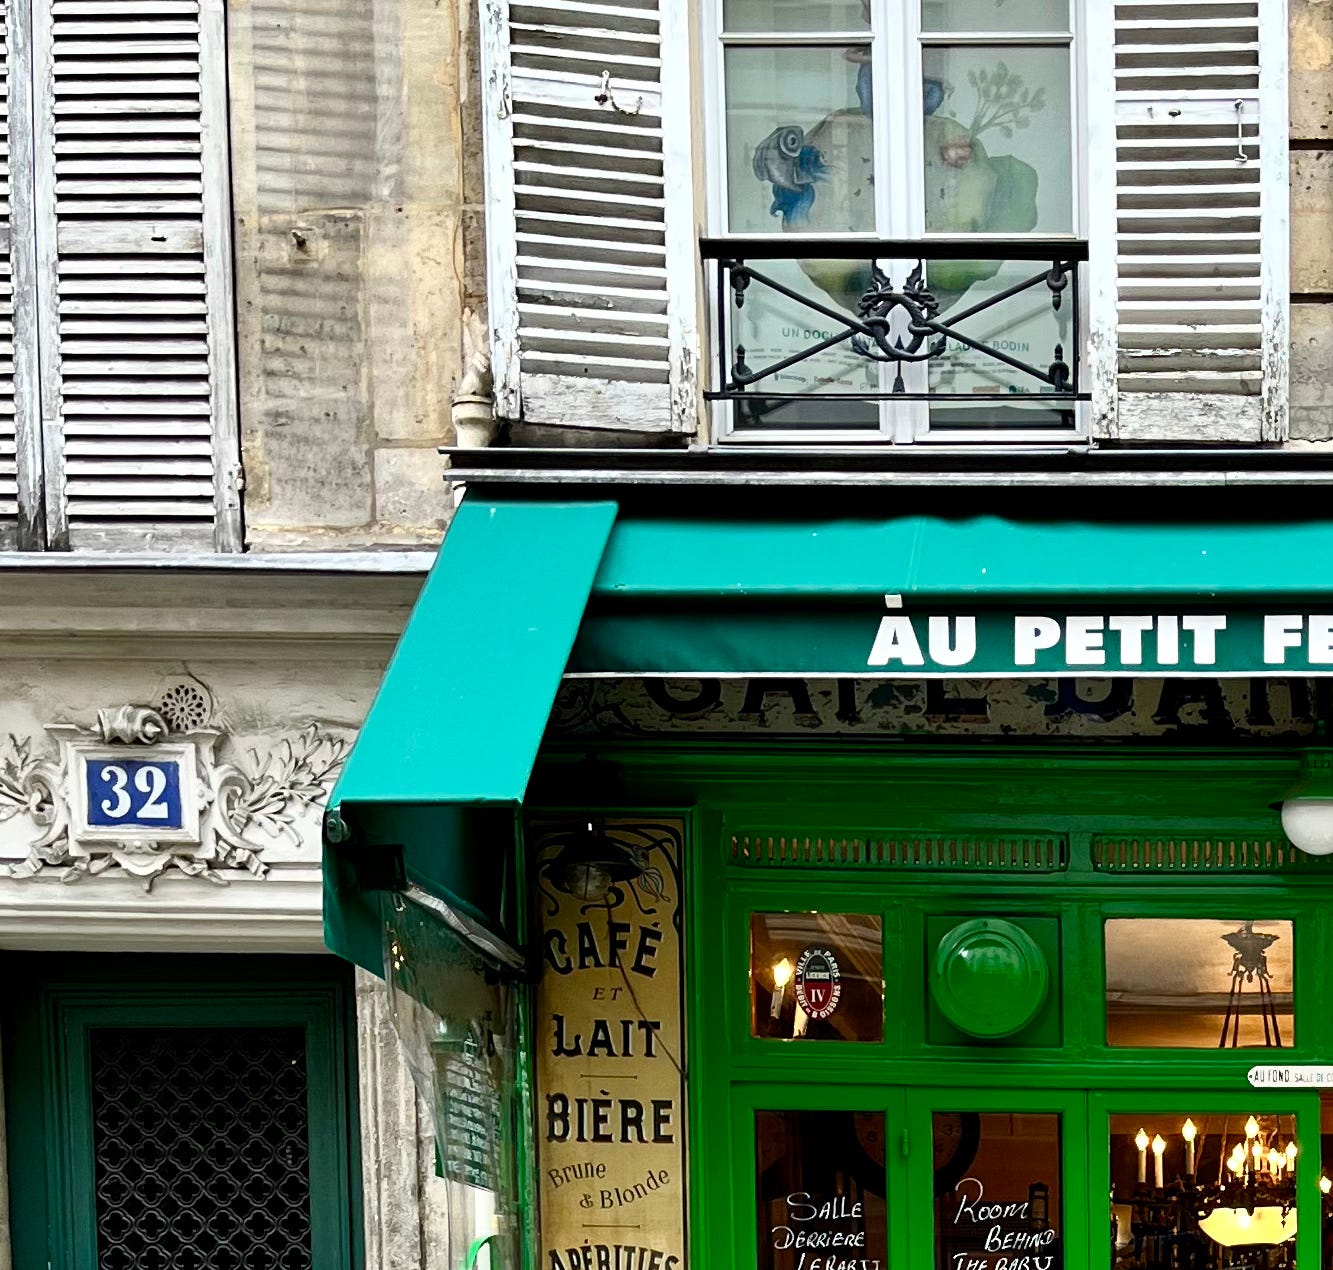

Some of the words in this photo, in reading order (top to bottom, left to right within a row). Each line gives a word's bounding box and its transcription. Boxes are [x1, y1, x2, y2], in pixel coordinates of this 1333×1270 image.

[866, 614, 976, 665] AU
[1013, 614, 1227, 665] PETIT
[100, 765, 169, 819] 32
[544, 922, 664, 979] CAFÉ
[824, 950, 841, 978] PARIS
[592, 987, 623, 1001] ET
[810, 988, 826, 1003] IV
[552, 1013, 661, 1058] LAIT
[1253, 1069, 1265, 1083] AU
[546, 1089, 675, 1144] BIÈRE
[548, 1161, 606, 1188] Brune
[579, 1193, 594, 1208] &
[600, 1169, 670, 1209] Blonde
[984, 1225, 1057, 1252] BEHIND
